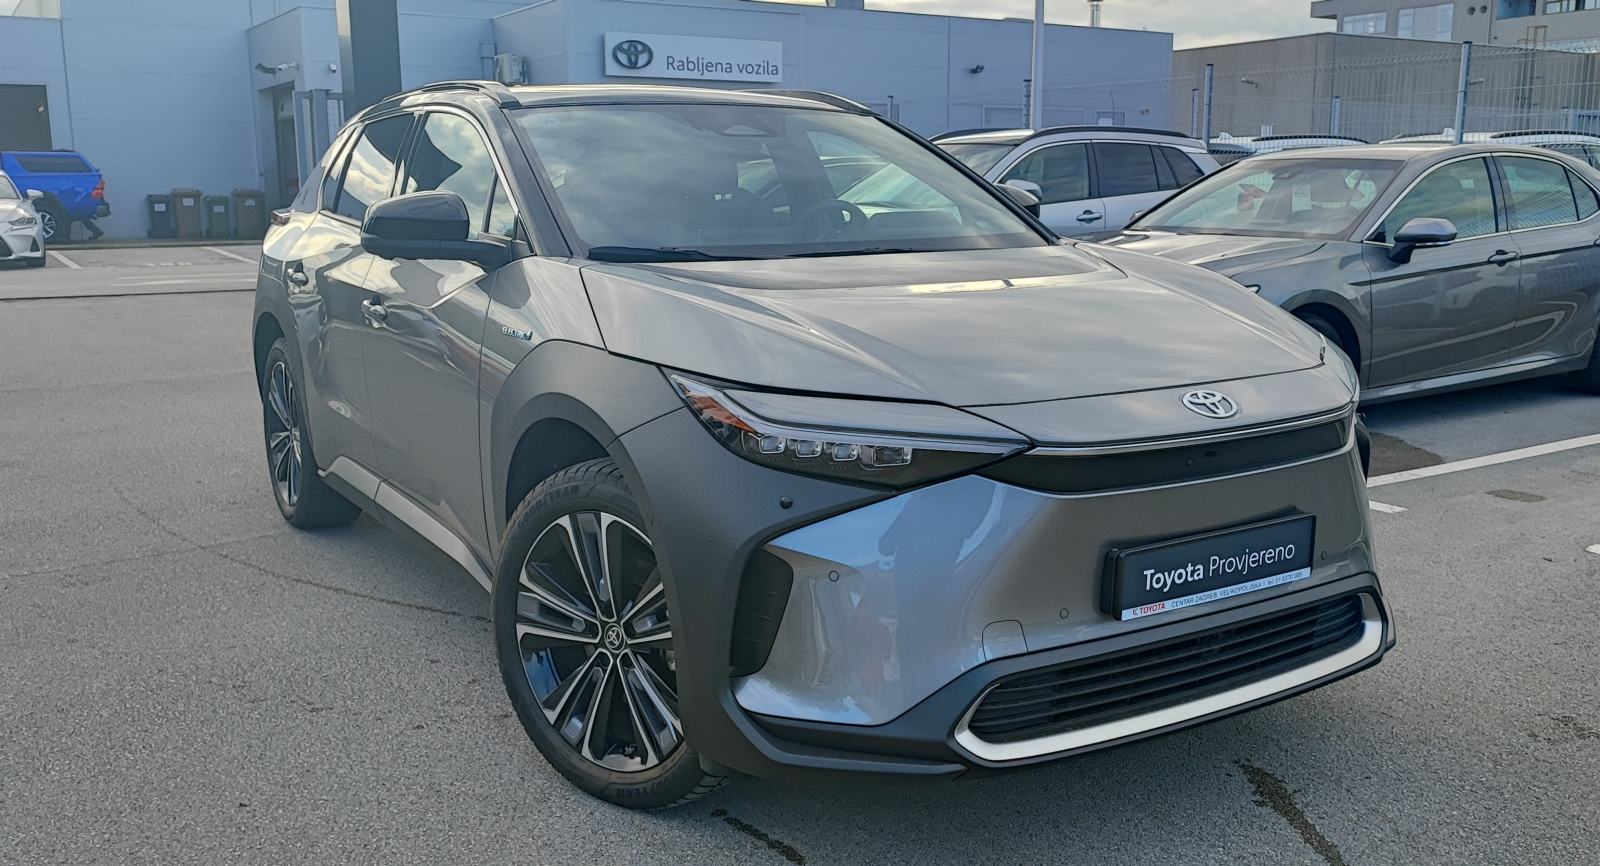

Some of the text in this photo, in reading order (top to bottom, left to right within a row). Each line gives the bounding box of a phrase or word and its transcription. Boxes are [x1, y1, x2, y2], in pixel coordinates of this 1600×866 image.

[666, 55, 779, 76] Rabljena vozila
[1143, 544, 1295, 592] Toyota Provjereno
[1140, 602, 1166, 615] TOYOTA
[1171, 598, 1194, 608] CENTAR
[1194, 593, 1219, 604] ZAGREB
